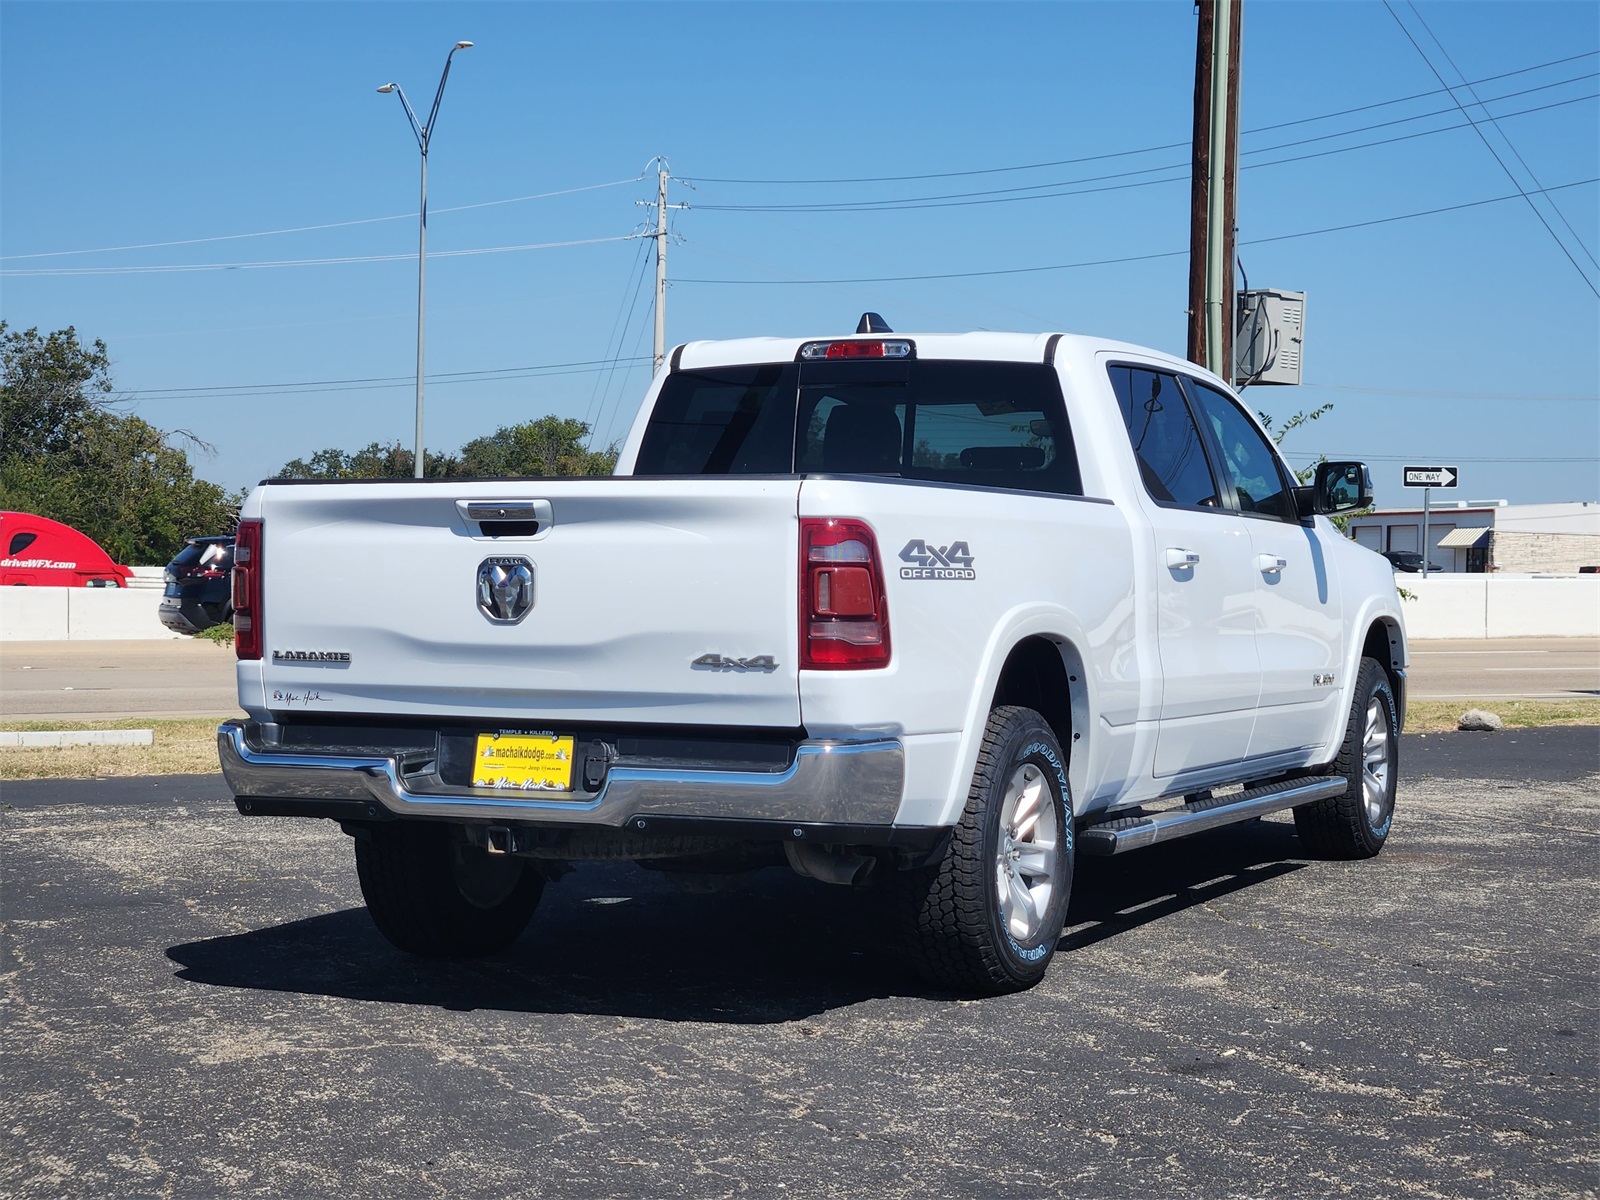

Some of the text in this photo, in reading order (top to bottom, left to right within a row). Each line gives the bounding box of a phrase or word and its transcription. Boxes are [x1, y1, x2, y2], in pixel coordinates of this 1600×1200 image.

[1408, 472, 1441, 482] ONE WAY
[0, 558, 77, 569] driveWFX.com
[901, 568, 975, 579] OFF ROAD
[272, 650, 351, 661] LARAMIE
[283, 690, 328, 706] Mac Haik
[495, 746, 555, 762] machaikdodge.com
[494, 776, 548, 790] Mac Haik
[1023, 742, 1074, 851] GOODYEAR
